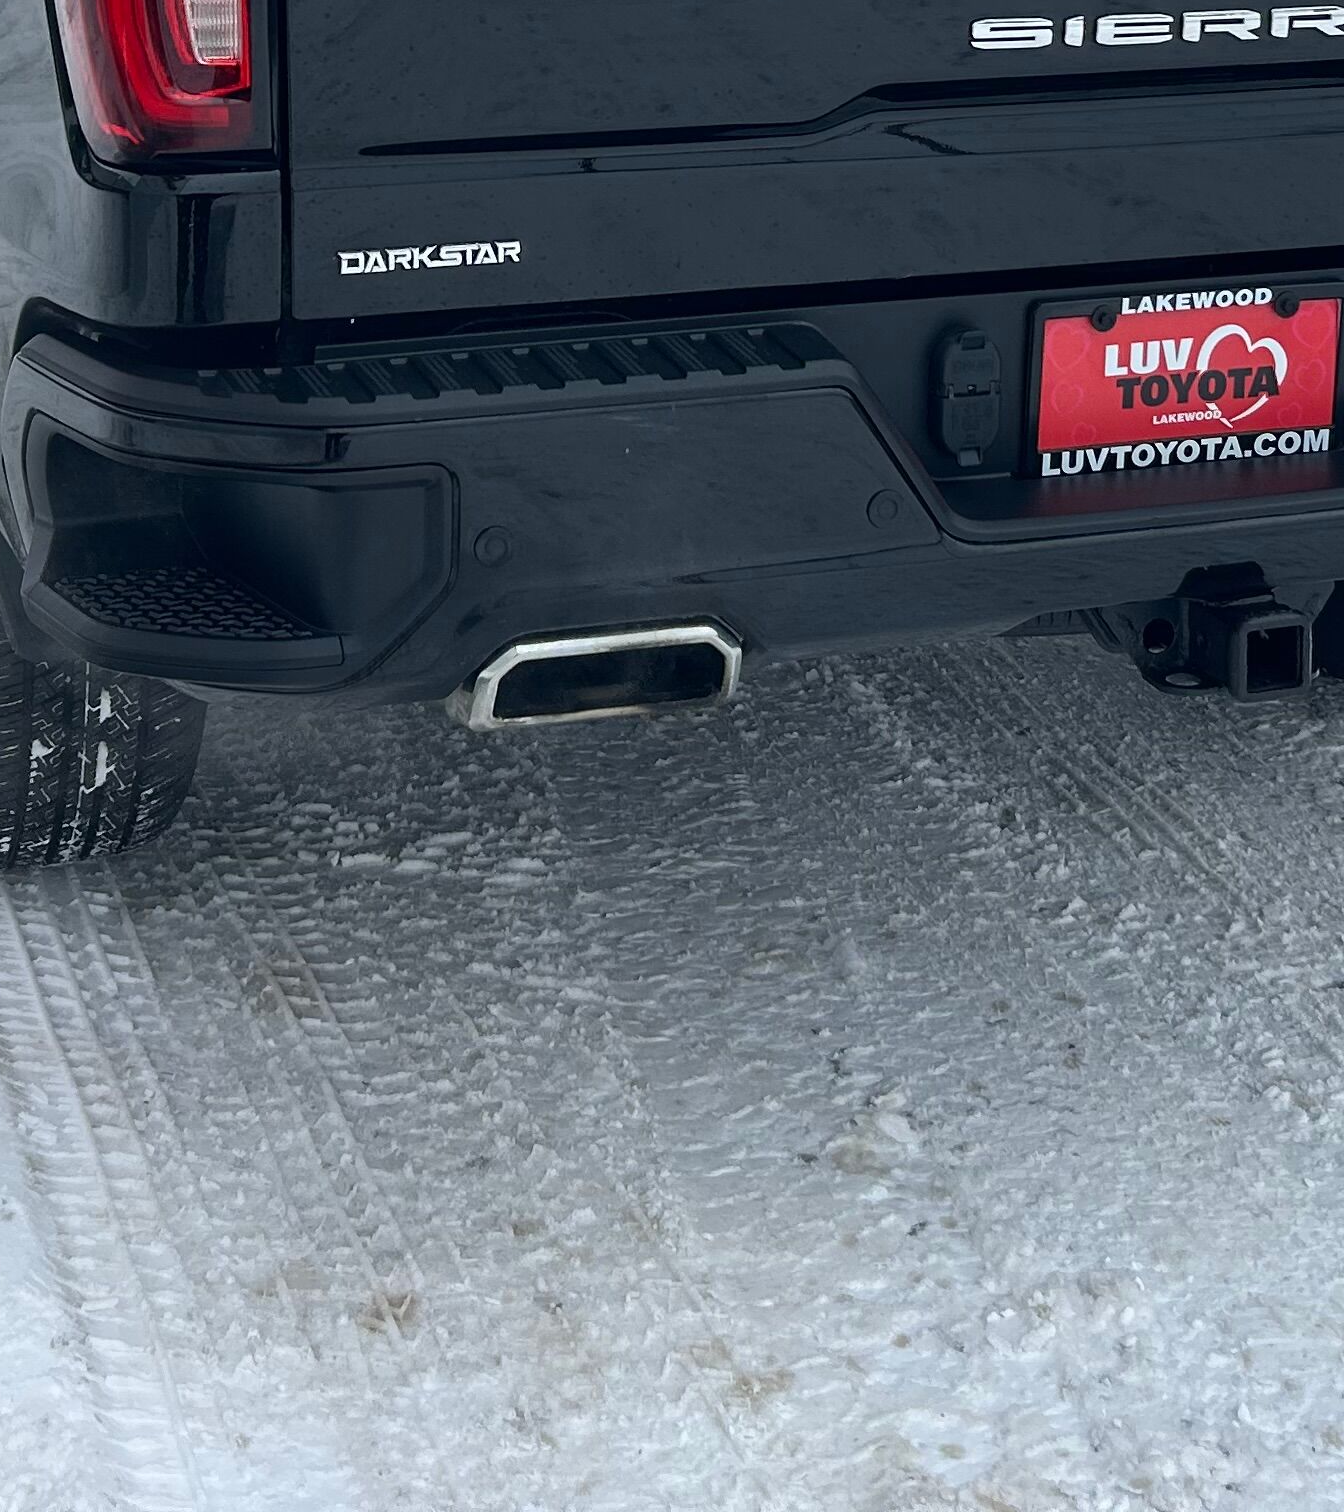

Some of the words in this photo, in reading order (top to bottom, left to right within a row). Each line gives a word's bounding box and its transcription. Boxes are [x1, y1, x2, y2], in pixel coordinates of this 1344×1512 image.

[337, 240, 521, 275] DARKSTAR
[1121, 287, 1273, 315] LAKEWOOD
[1104, 337, 1194, 378] LUV
[1116, 365, 1280, 409] TOYOTA
[1152, 408, 1223, 425] LAKEWOOD
[1041, 428, 1330, 477] LUVTOYOTA.COM
